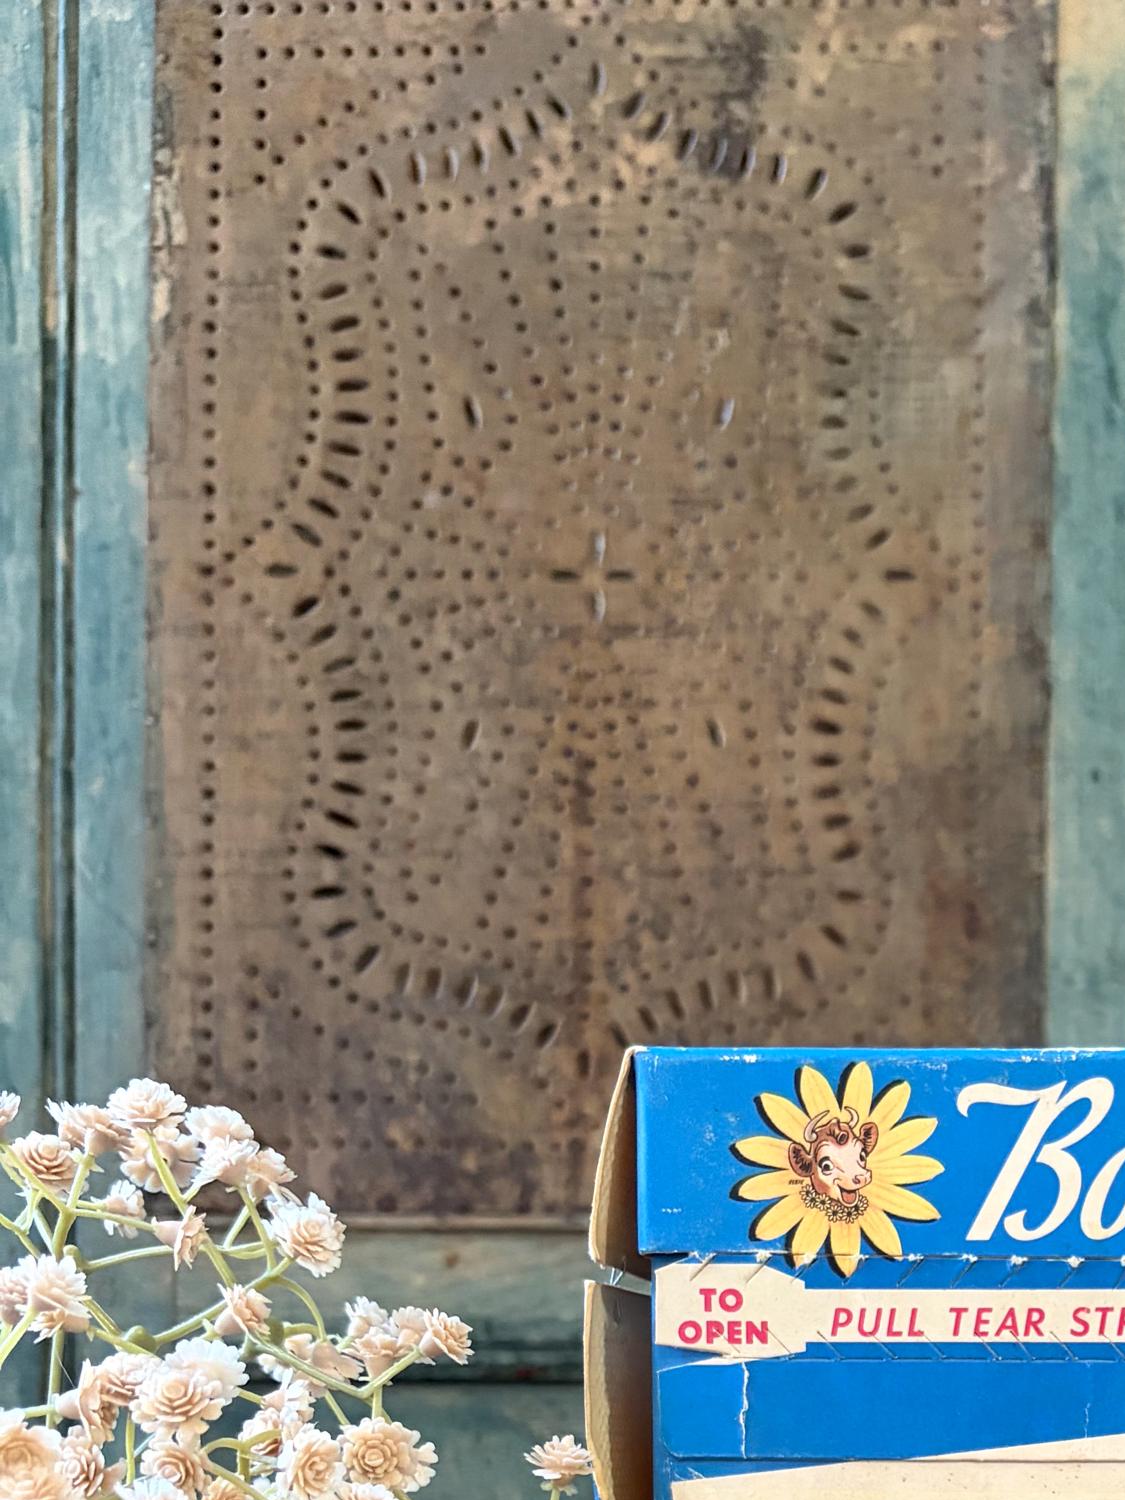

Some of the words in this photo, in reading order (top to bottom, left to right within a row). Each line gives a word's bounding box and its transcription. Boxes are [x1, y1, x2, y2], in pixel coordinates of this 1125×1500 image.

[699, 1287, 744, 1313] TO
[678, 1320, 769, 1345] OPEN
[830, 1306, 925, 1337] PULL
[948, 1307, 1047, 1337] TEAR
